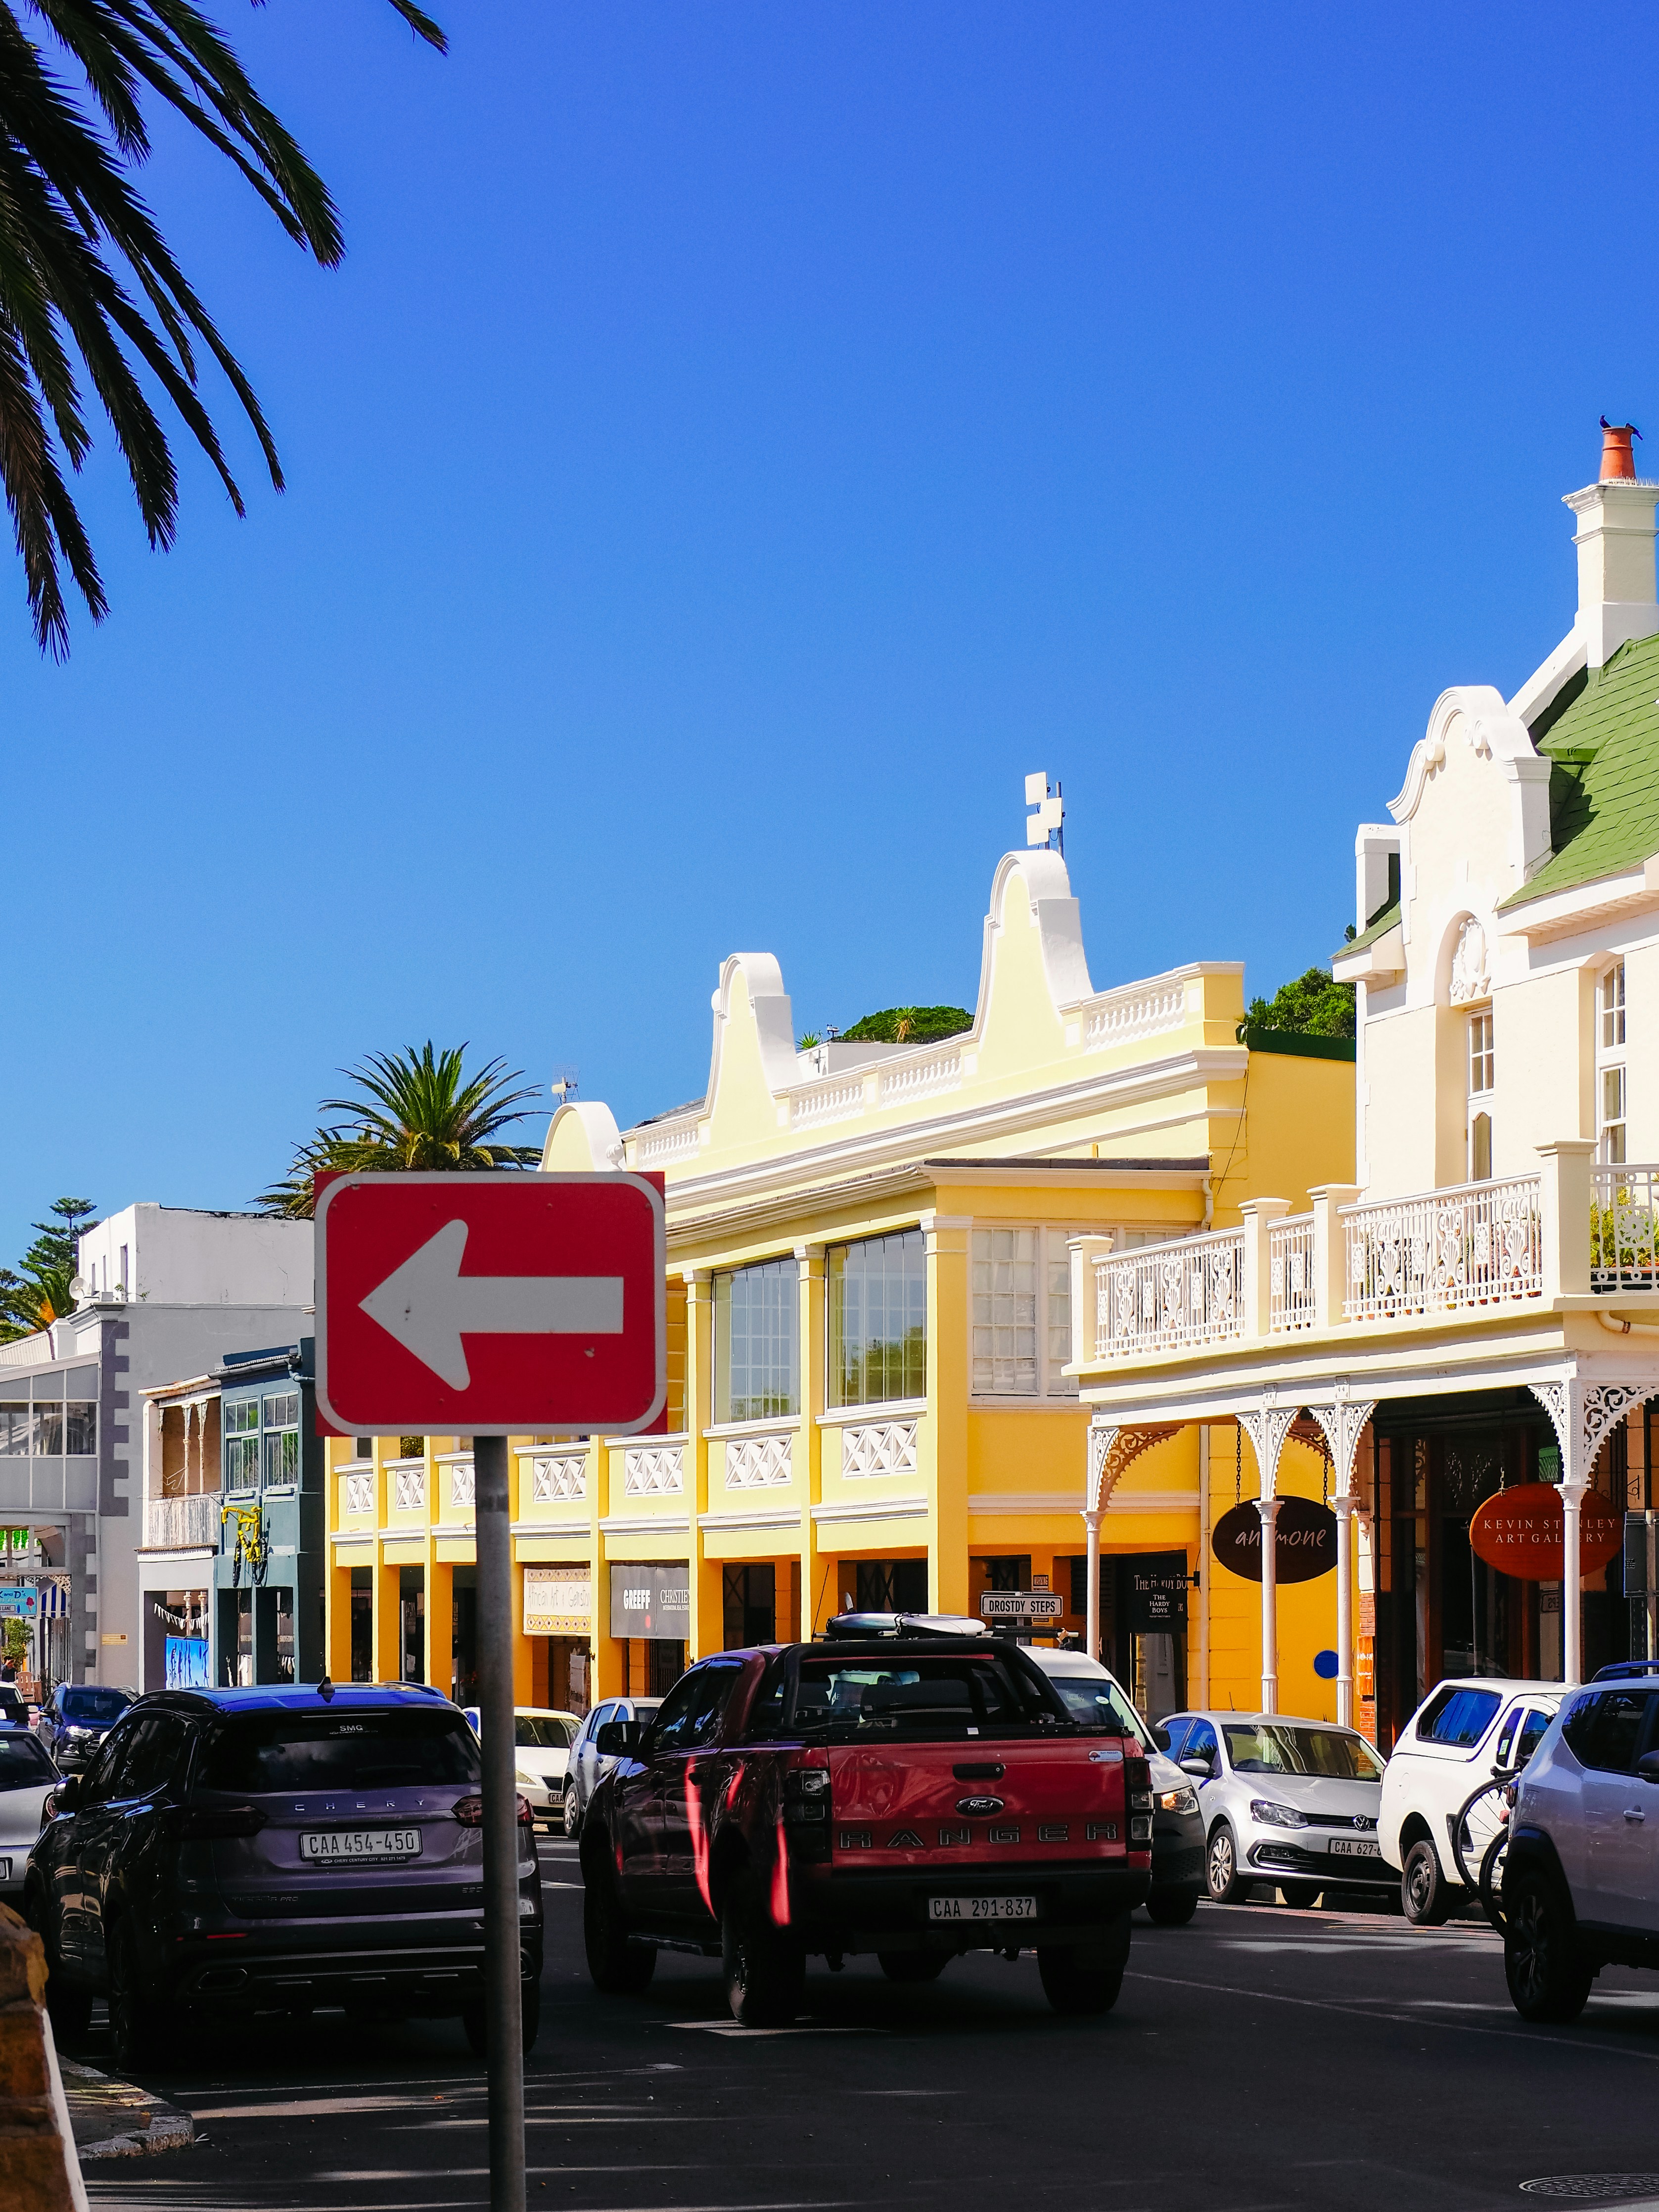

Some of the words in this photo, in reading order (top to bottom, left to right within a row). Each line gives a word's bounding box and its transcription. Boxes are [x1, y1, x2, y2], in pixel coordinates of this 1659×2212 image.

[1484, 1520, 1533, 1529] KEVIN
[1543, 1519, 1615, 1529] STLEY
[1495, 1534, 1524, 1543] ART
[1531, 1533, 1605, 1543] GALRY
[623, 1589, 650, 1610] GREEFF
[989, 1600, 1025, 1612] DROSTDY
[1030, 1601, 1056, 1613] STEPS
[295, 1800, 424, 1811] CHERY
[968, 1800, 993, 1811] Ford
[840, 1823, 1116, 1848] RANGER
[310, 1836, 339, 1854] CAA
[344, 1832, 414, 1853] 454-450
[1335, 1842, 1351, 1854] CAA
[934, 1900, 961, 1917] CAA
[971, 1898, 1032, 1917] 291-837
